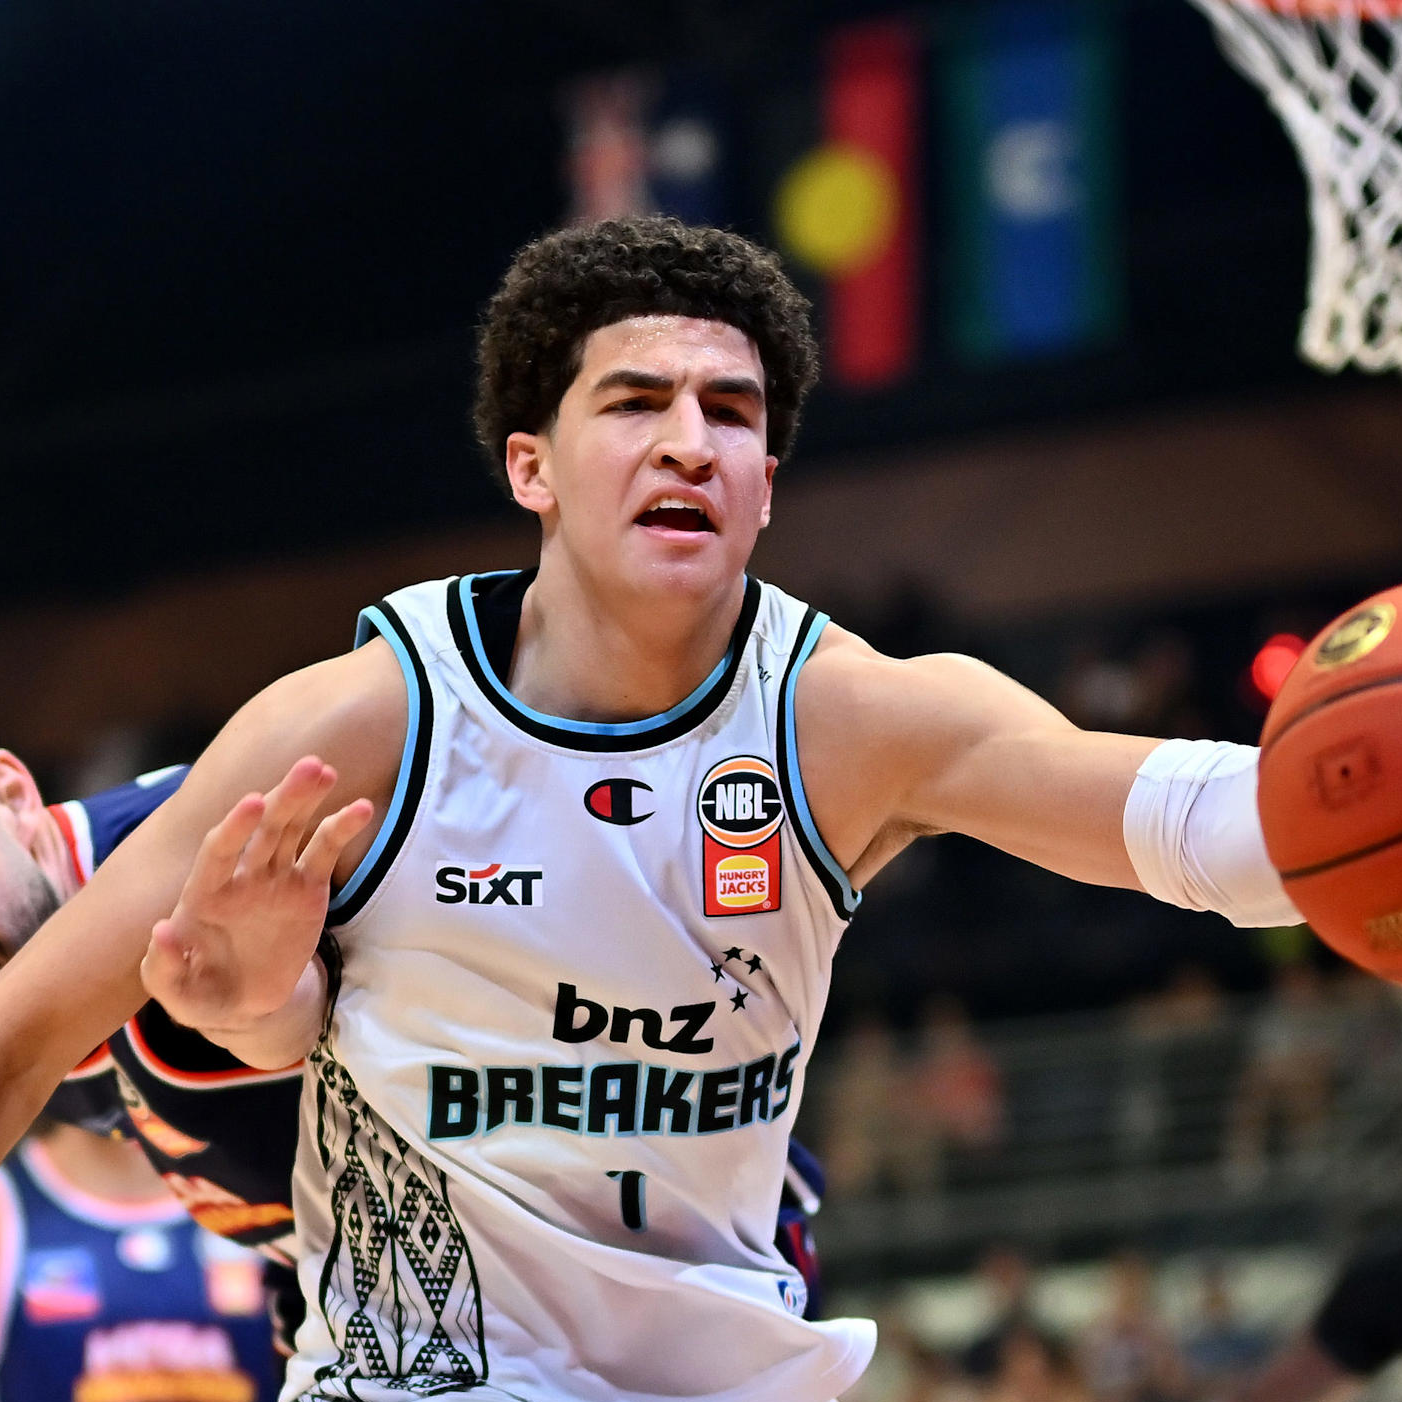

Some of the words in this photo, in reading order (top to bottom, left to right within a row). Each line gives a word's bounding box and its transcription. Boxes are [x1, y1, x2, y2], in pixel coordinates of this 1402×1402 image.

[715, 782, 768, 821] NBL
[718, 869, 766, 882] HUNGRY
[719, 880, 767, 896] JACK'S
[552, 982, 717, 1055] bnz
[426, 1037, 802, 1143] BREAKERS
[605, 1169, 648, 1234] 1
